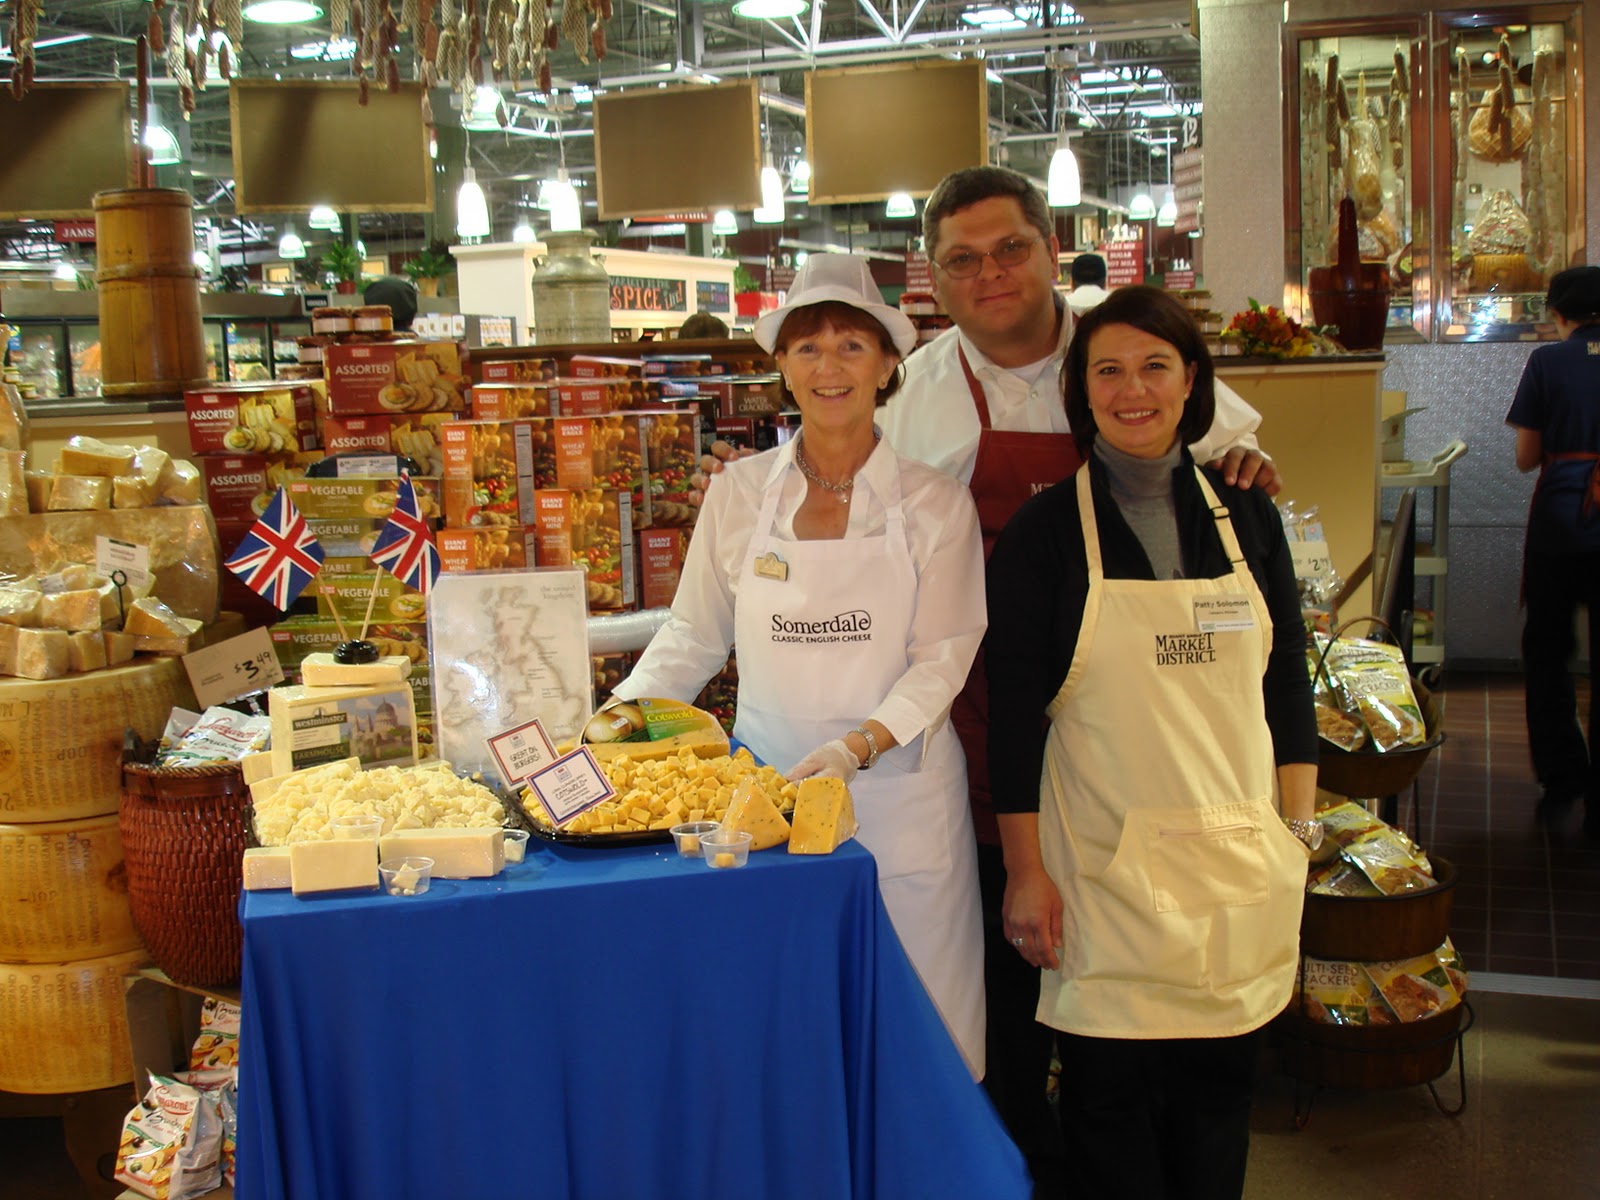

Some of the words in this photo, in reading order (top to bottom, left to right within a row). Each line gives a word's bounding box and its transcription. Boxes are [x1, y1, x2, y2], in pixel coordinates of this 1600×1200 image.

[62, 228, 95, 238] JAMS
[610, 285, 662, 310] SPICE
[335, 364, 390, 375] ASSORTED
[744, 397, 768, 405] WATER
[739, 404, 775, 412] CRACKERS
[190, 409, 235, 420] ASSORTED
[330, 436, 385, 448] ASSORTED
[210, 473, 262, 486] ASSORTED
[310, 486, 364, 495] VEGETABLE
[337, 588, 390, 597] VEGETABLE
[1194, 601, 1215, 609] Patty
[1216, 600, 1250, 608] Solomon
[772, 609, 872, 634] Somerdale
[293, 633, 344, 643] VEGETABL
[772, 634, 803, 643] CLASSIC
[806, 634, 840, 643] ENGLISH
[842, 633, 872, 642] CHEESE
[1155, 632, 1215, 652] MARKET
[1156, 650, 1216, 666] DISTRICT
[647, 708, 694, 722] Cotswold
[294, 713, 347, 729] westminster
[294, 746, 345, 760] FARMHOUSE
